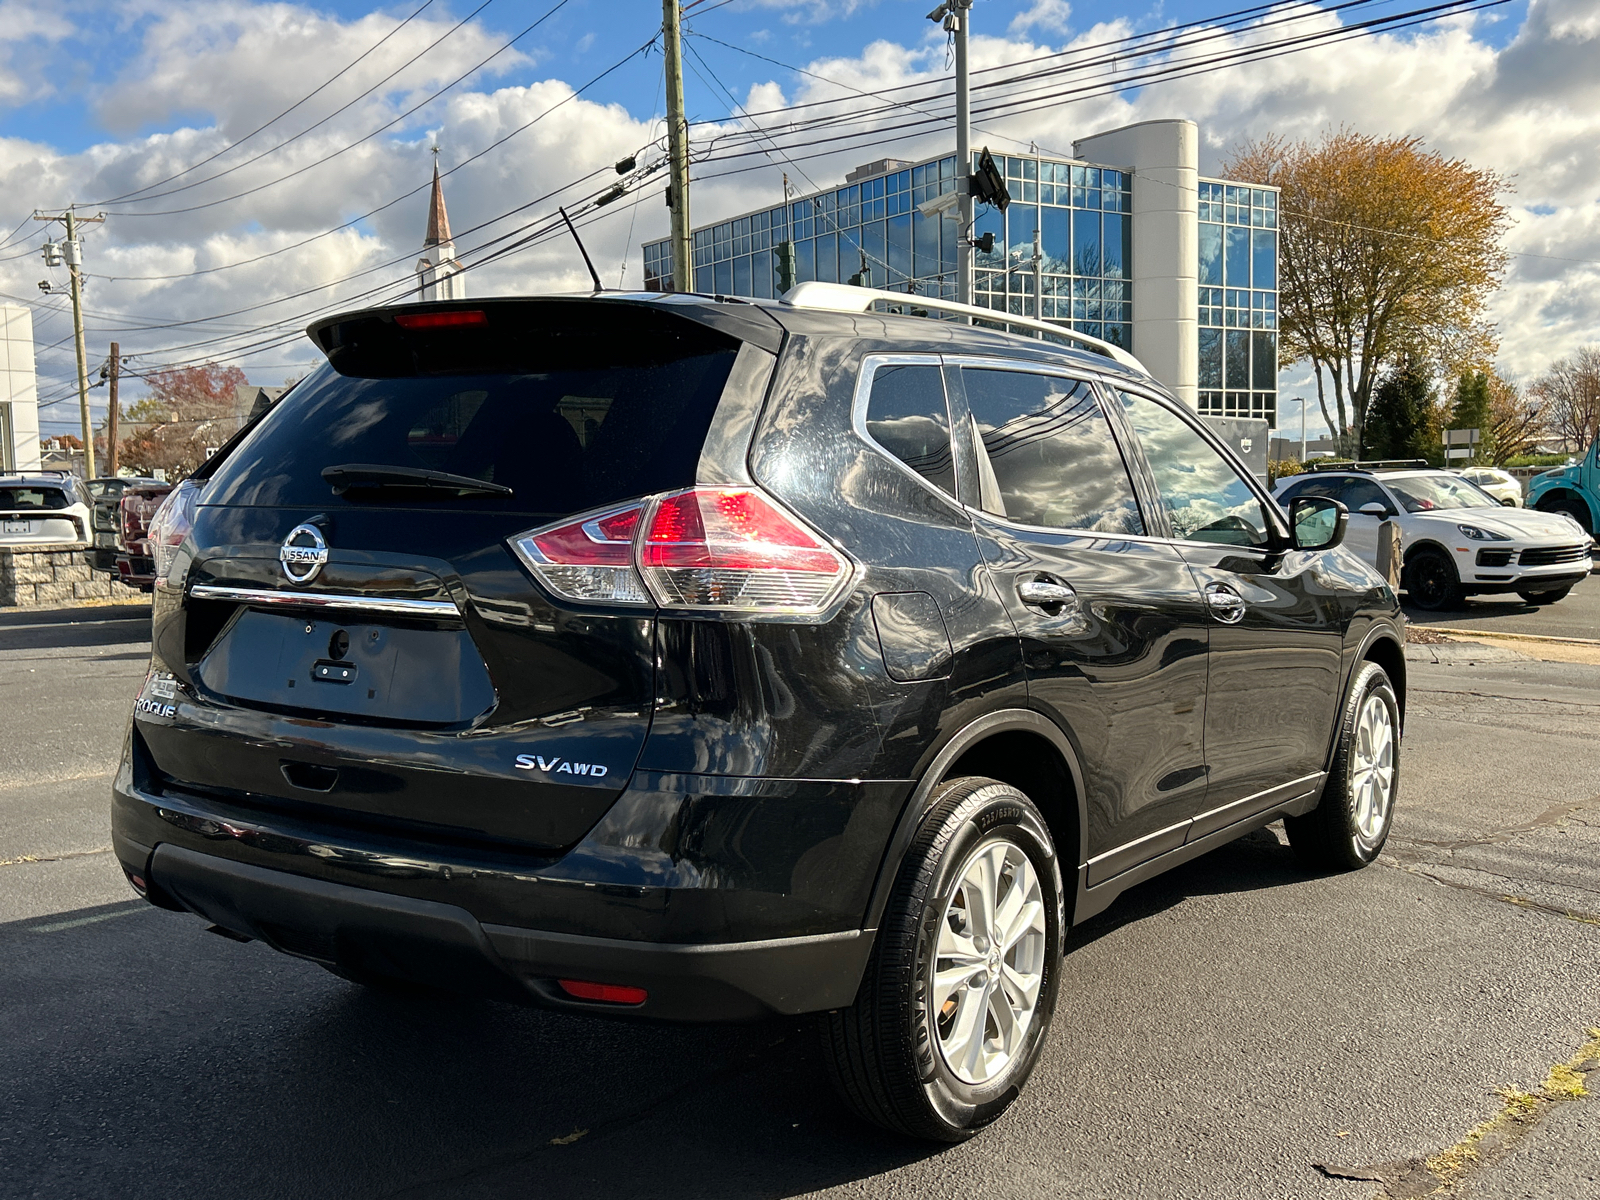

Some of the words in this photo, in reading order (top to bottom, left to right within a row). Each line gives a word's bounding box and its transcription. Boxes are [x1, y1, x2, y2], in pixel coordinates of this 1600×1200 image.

[281, 549, 320, 561] NISSAN
[136, 698, 176, 718] ROGUE
[981, 807, 1020, 829] 225/65R17
